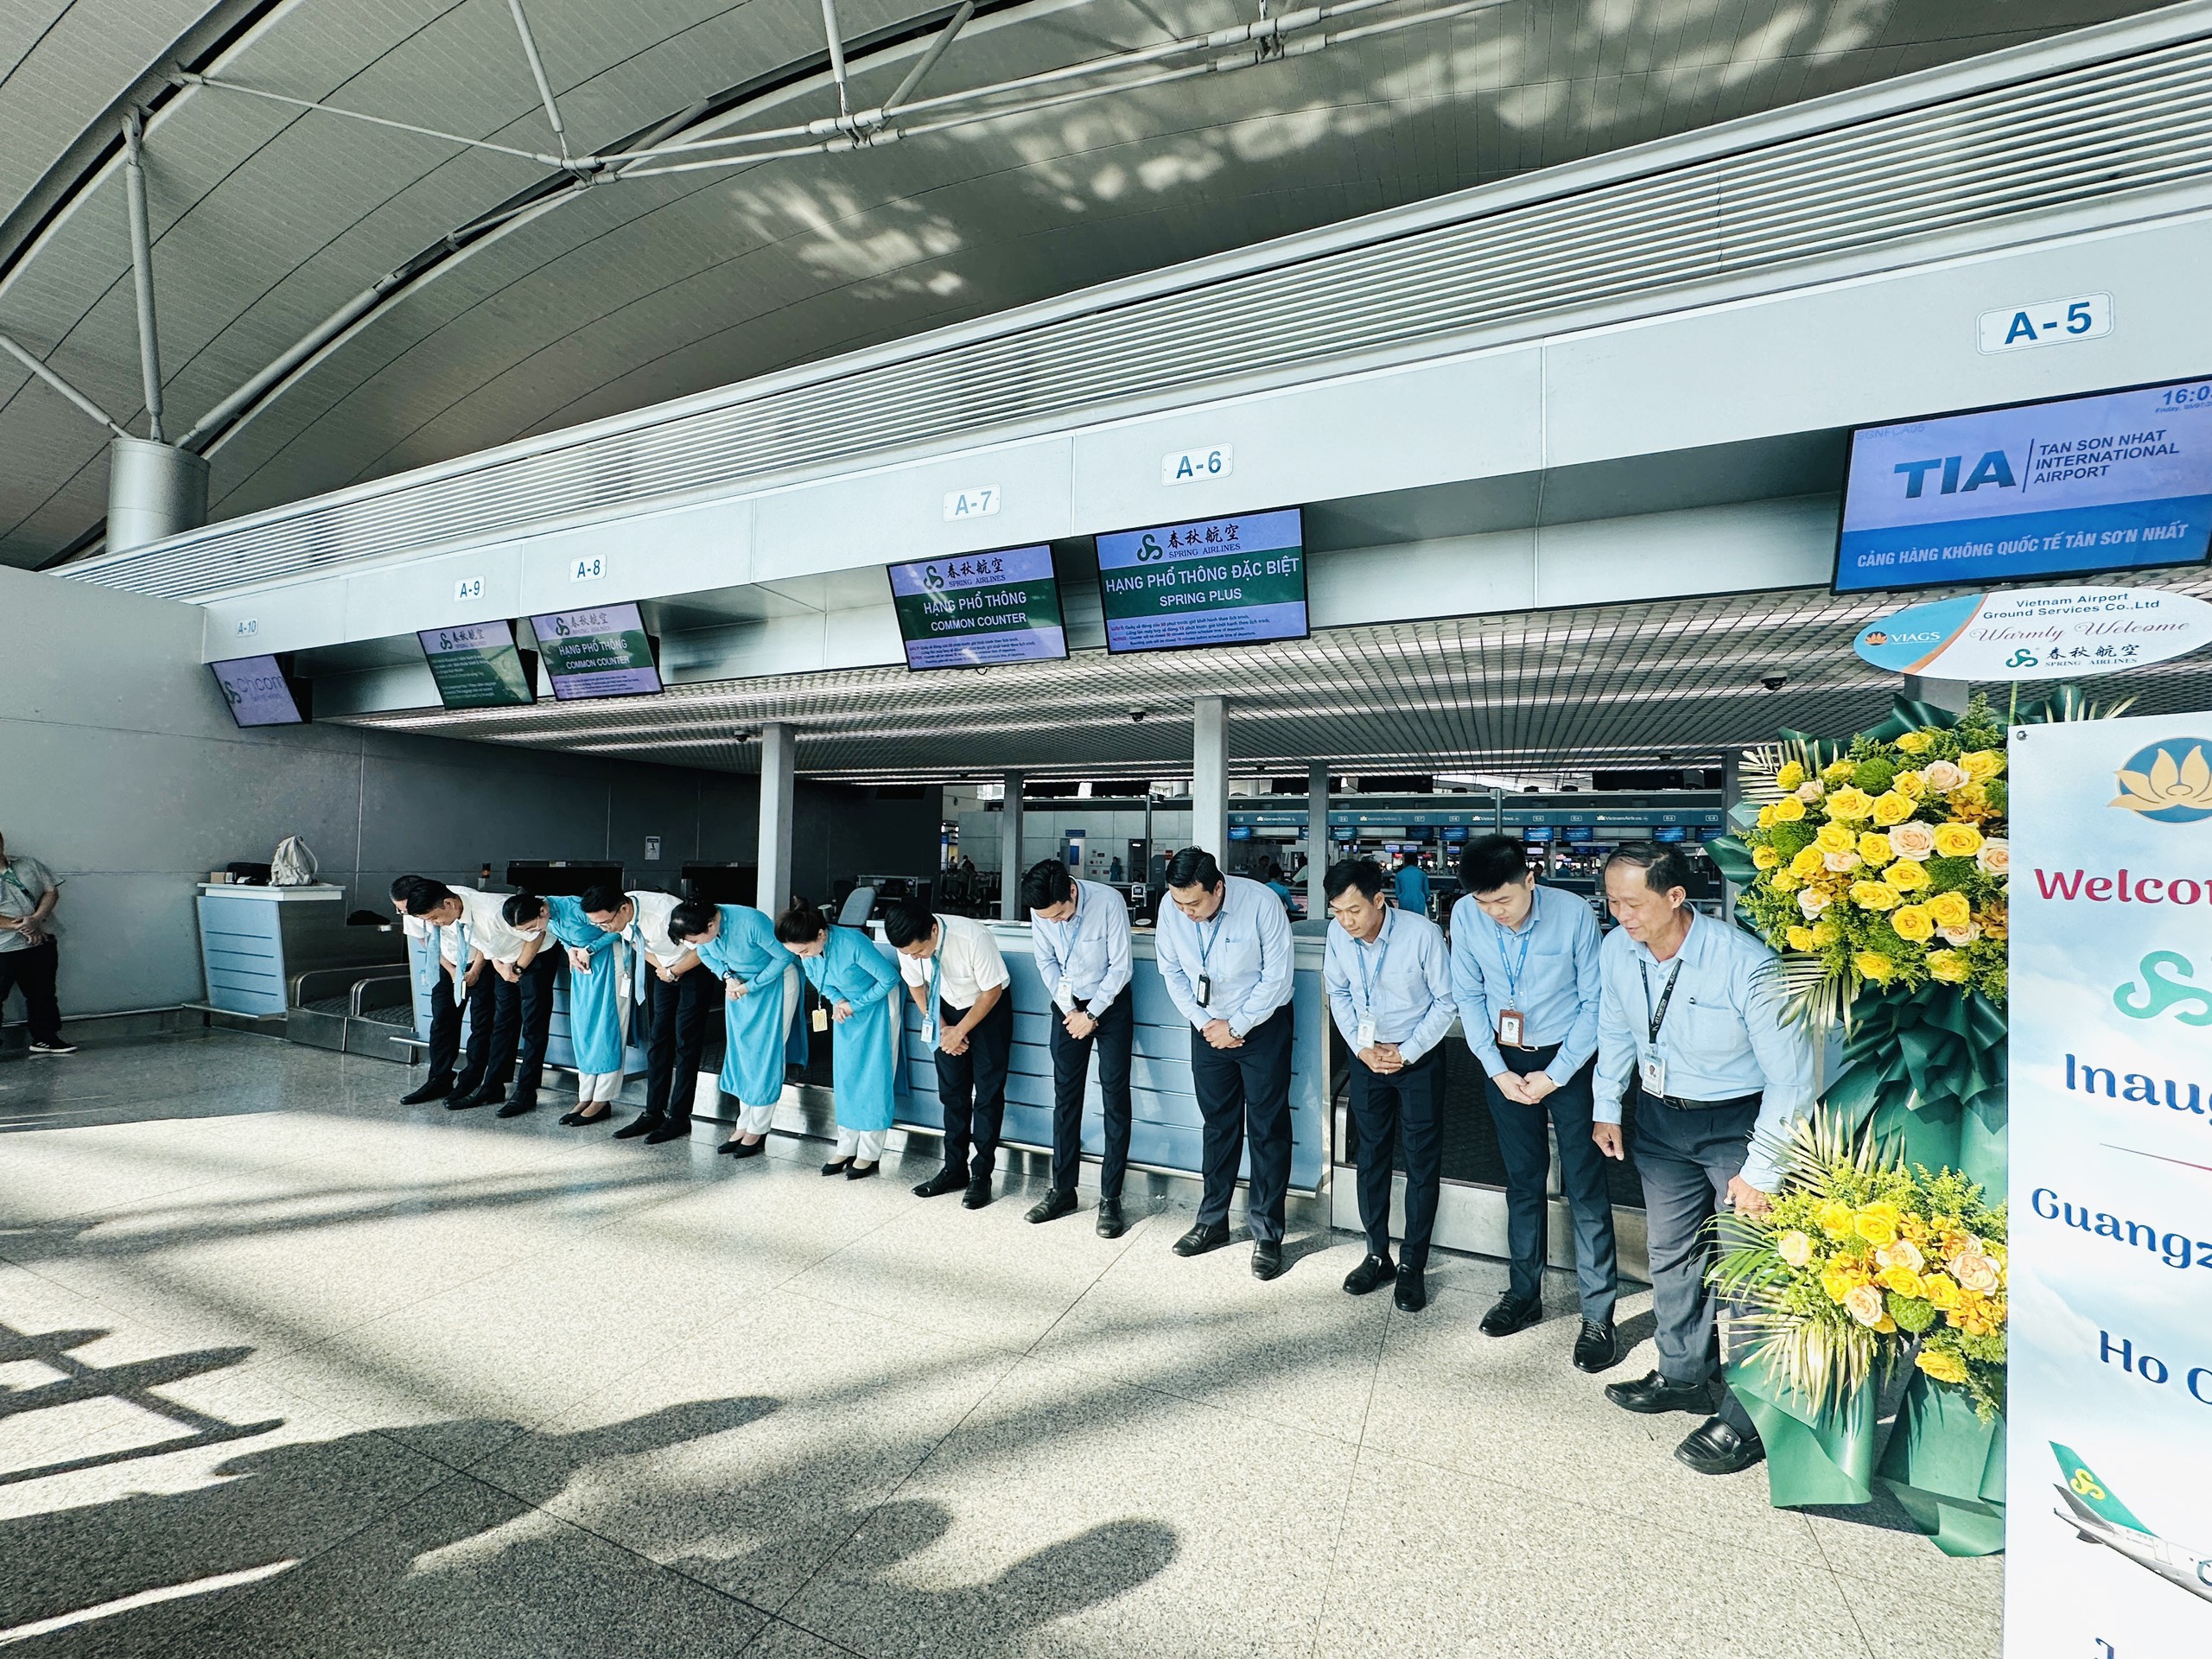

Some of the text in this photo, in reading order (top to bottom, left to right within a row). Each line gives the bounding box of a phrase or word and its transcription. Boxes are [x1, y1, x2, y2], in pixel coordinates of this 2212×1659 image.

[2004, 302, 2092, 345] A-5
[2163, 385, 2212, 405] 16:0
[2039, 429, 2167, 455] TAN SON NHAT
[1176, 451, 1222, 479] A-6
[2036, 442, 2180, 470] INTERNATIONAL
[1894, 449, 2017, 499] TIA
[2034, 465, 2110, 484] AIRPORT
[955, 490, 992, 516] A-7
[1167, 523, 1240, 550] 春秋航空
[1857, 520, 2189, 568] CẢNG HÀNG KHÔNG QUỐC TẾ TÂN SƠN NHẤT
[1168, 543, 1241, 558] SPRING AIRLINES
[577, 559, 601, 578] A-8
[947, 557, 1004, 579] 春秋航空
[1105, 555, 1300, 595] HẠNG PHỔ THÔNG ĐẶC BIỆT
[460, 581, 480, 598] A-9
[948, 575, 1007, 588] SPRING AIRLINES
[924, 591, 1027, 617] HẠNG PHỔ THÔNG
[1160, 588, 1243, 607] SPRING PLUS
[2016, 593, 2129, 607] Vietnam Airport
[1983, 600, 2160, 620] Ground Services Co.,Ltd
[237, 620, 257, 636] A-10
[931, 613, 1027, 632] COMMON COUNTER
[1969, 620, 2191, 643] Warmly Welcome
[1891, 631, 1941, 643] VIAGS
[558, 645, 582, 658] HẠNG
[600, 638, 627, 651] THÔNG
[2046, 644, 2140, 658] 春秋航空
[566, 655, 630, 670] COMMON COUNTER
[2065, 1053, 2212, 1126] Inau
[2099, 1330, 2169, 1384] Ho
